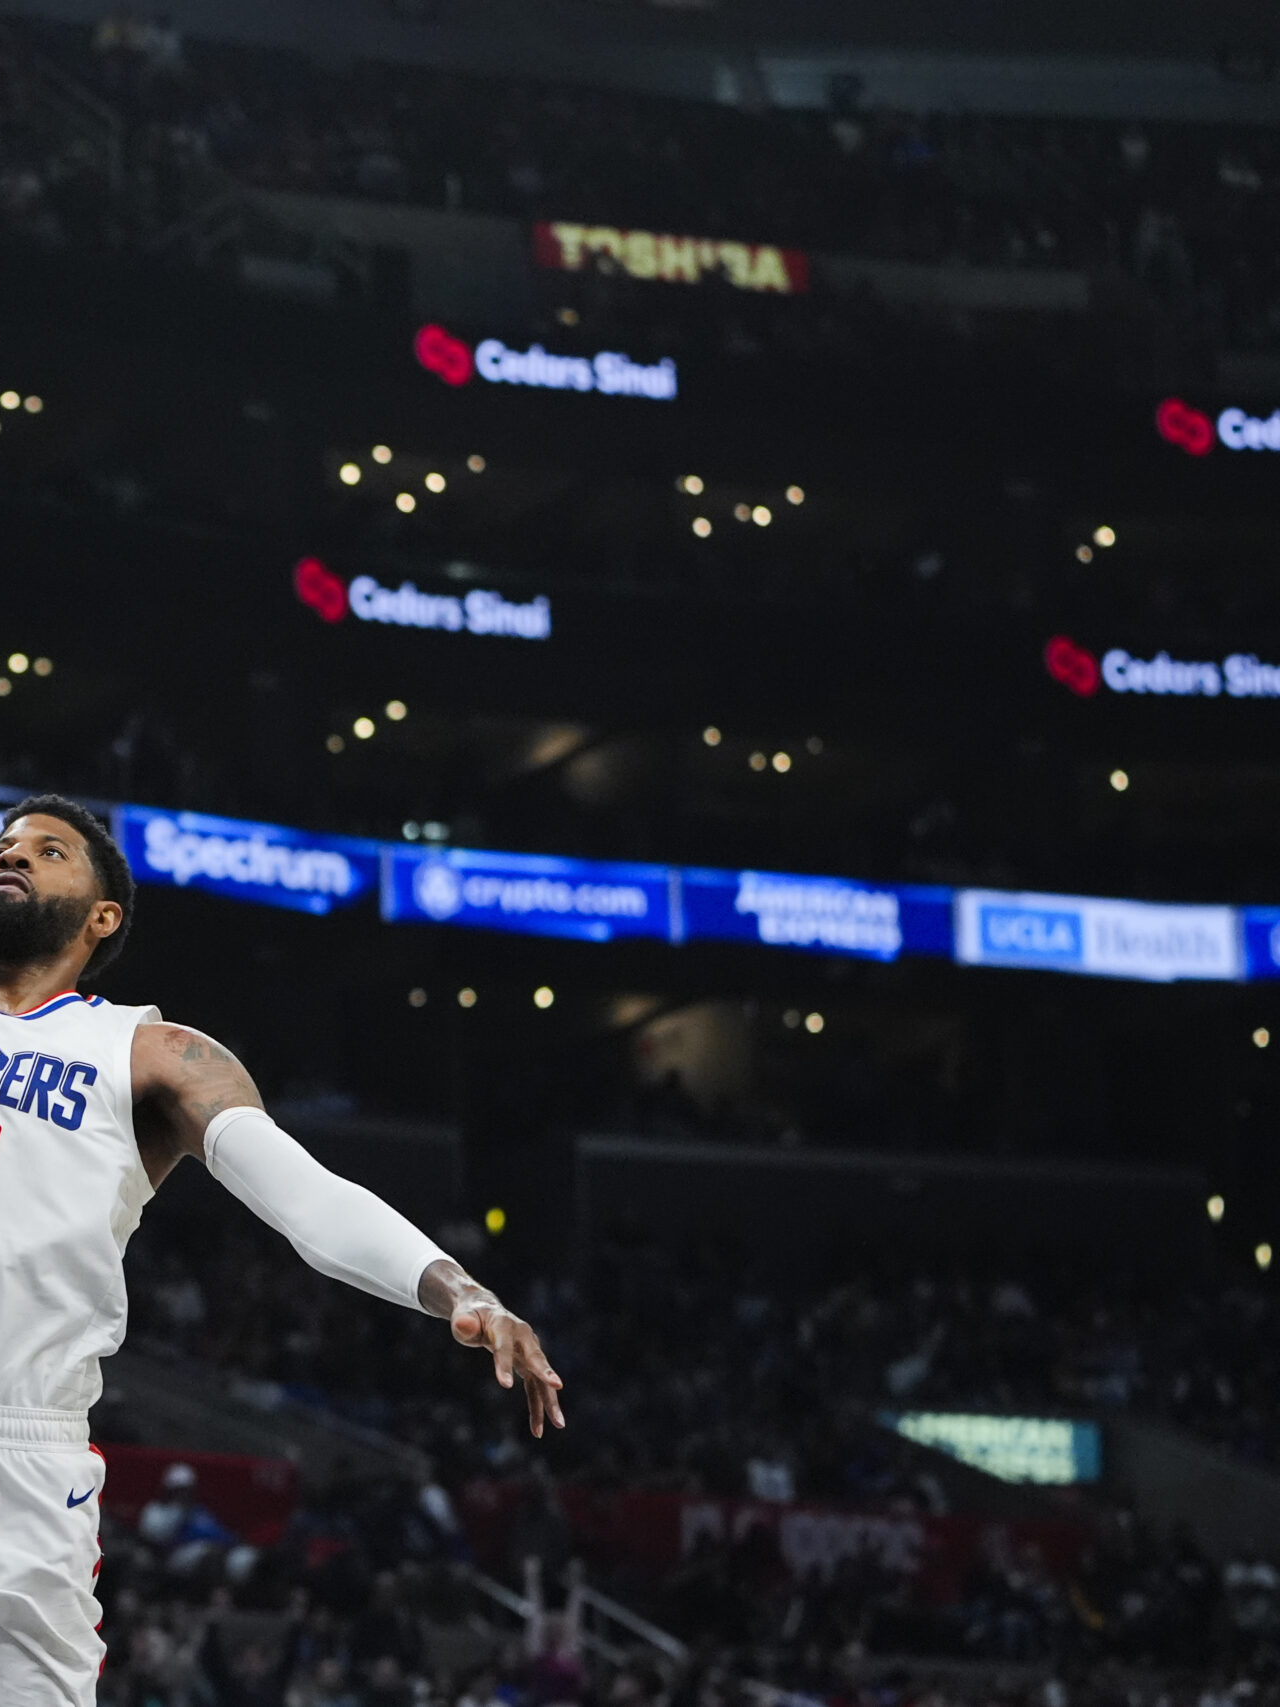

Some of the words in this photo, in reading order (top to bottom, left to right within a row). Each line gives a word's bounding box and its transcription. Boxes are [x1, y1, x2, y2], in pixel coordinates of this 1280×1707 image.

[144, 817, 357, 897] Spectrum
[463, 874, 648, 920] crypto.com
[985, 912, 1076, 950] UCLA
[1094, 914, 1222, 962] Health
